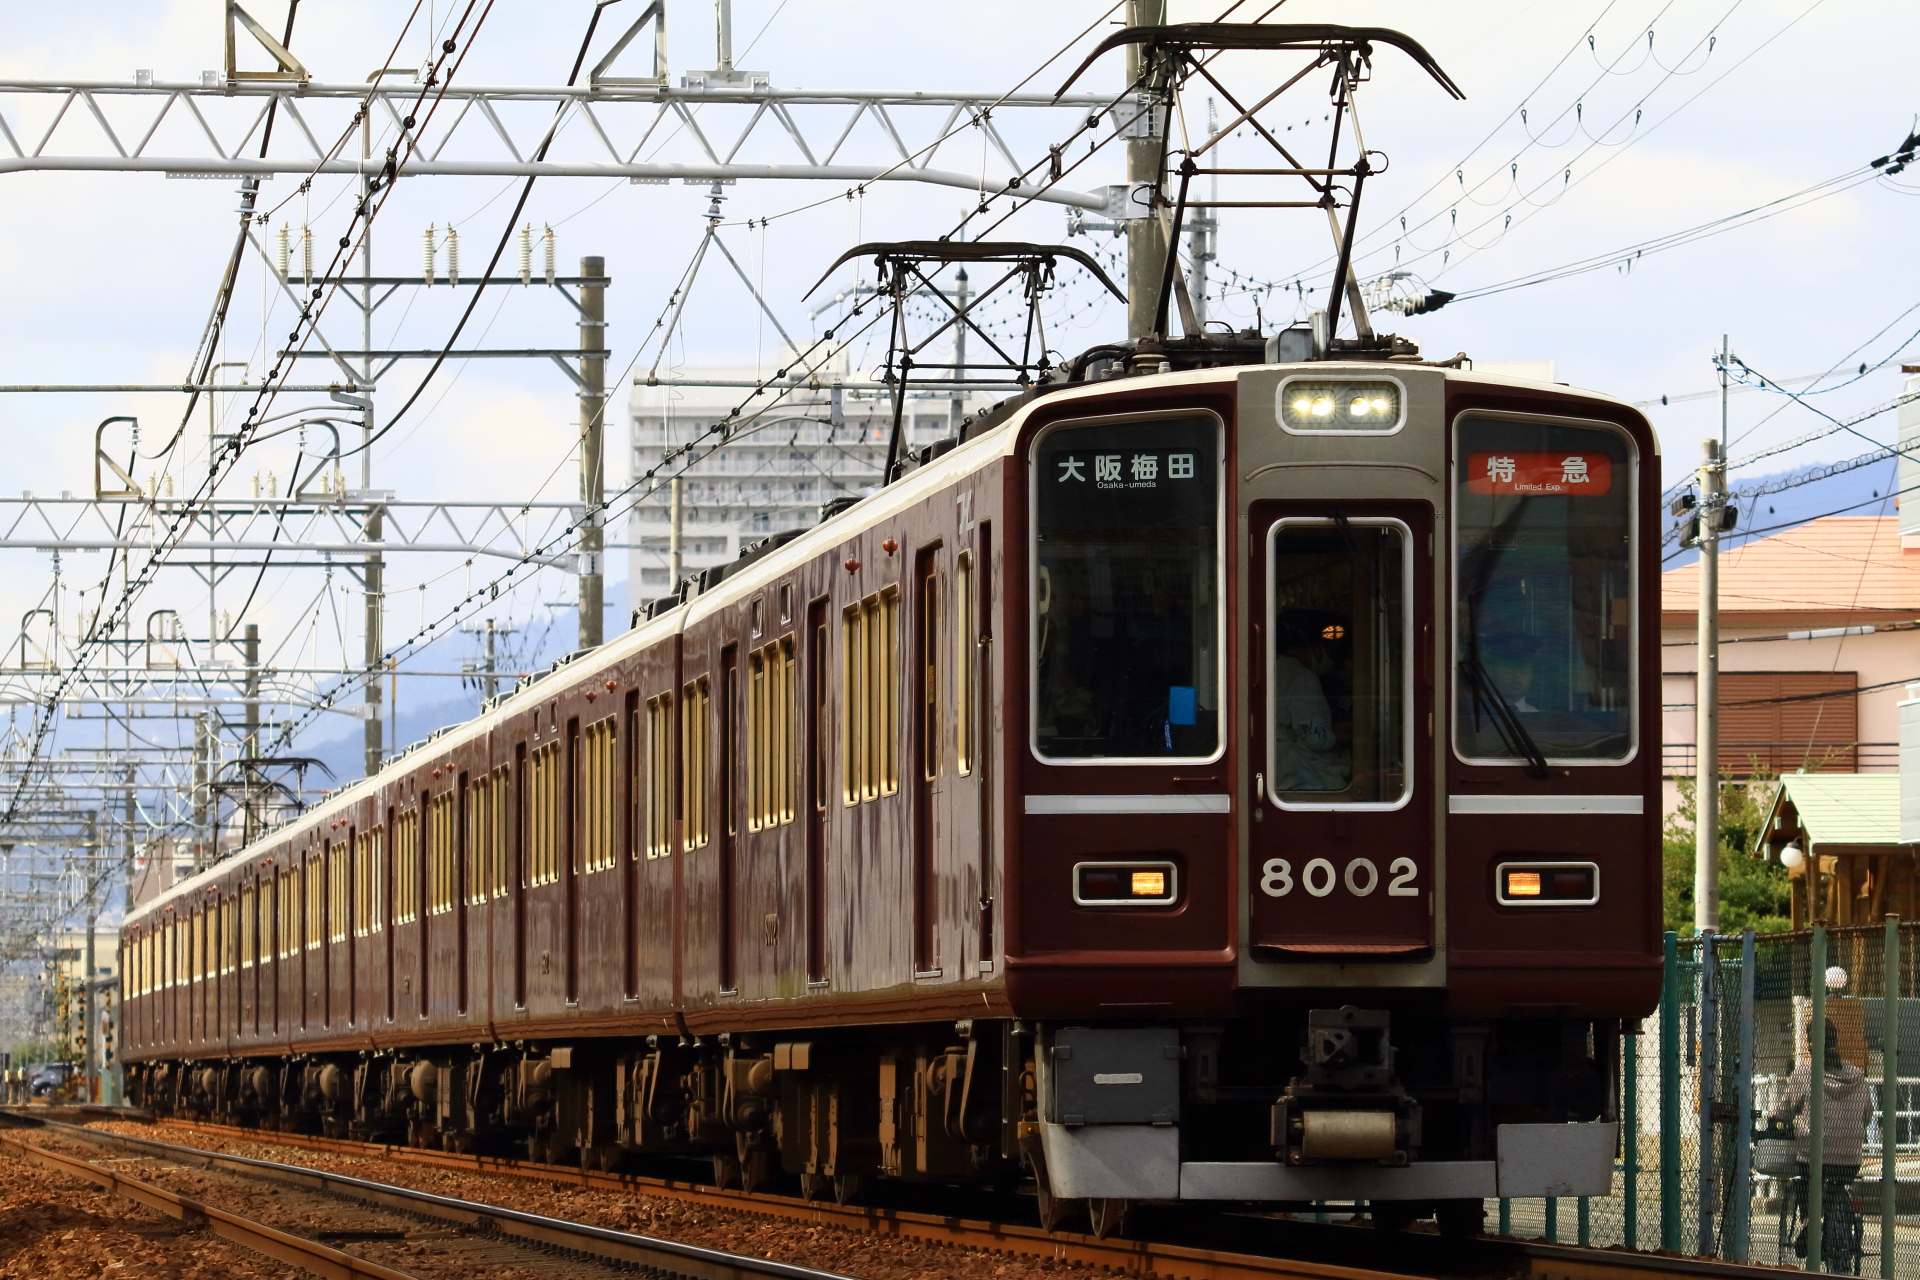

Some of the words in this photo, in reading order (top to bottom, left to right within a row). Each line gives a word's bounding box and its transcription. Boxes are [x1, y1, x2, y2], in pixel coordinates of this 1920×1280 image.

[1058, 454, 1194, 482] 大阪梅田
[1487, 456, 1590, 483] 特急
[1097, 481, 1157, 489] Osaka-umeda
[1514, 483, 1542, 491] Limited
[1545, 483, 1562, 491] Exp.
[1260, 857, 1419, 898] 8002
